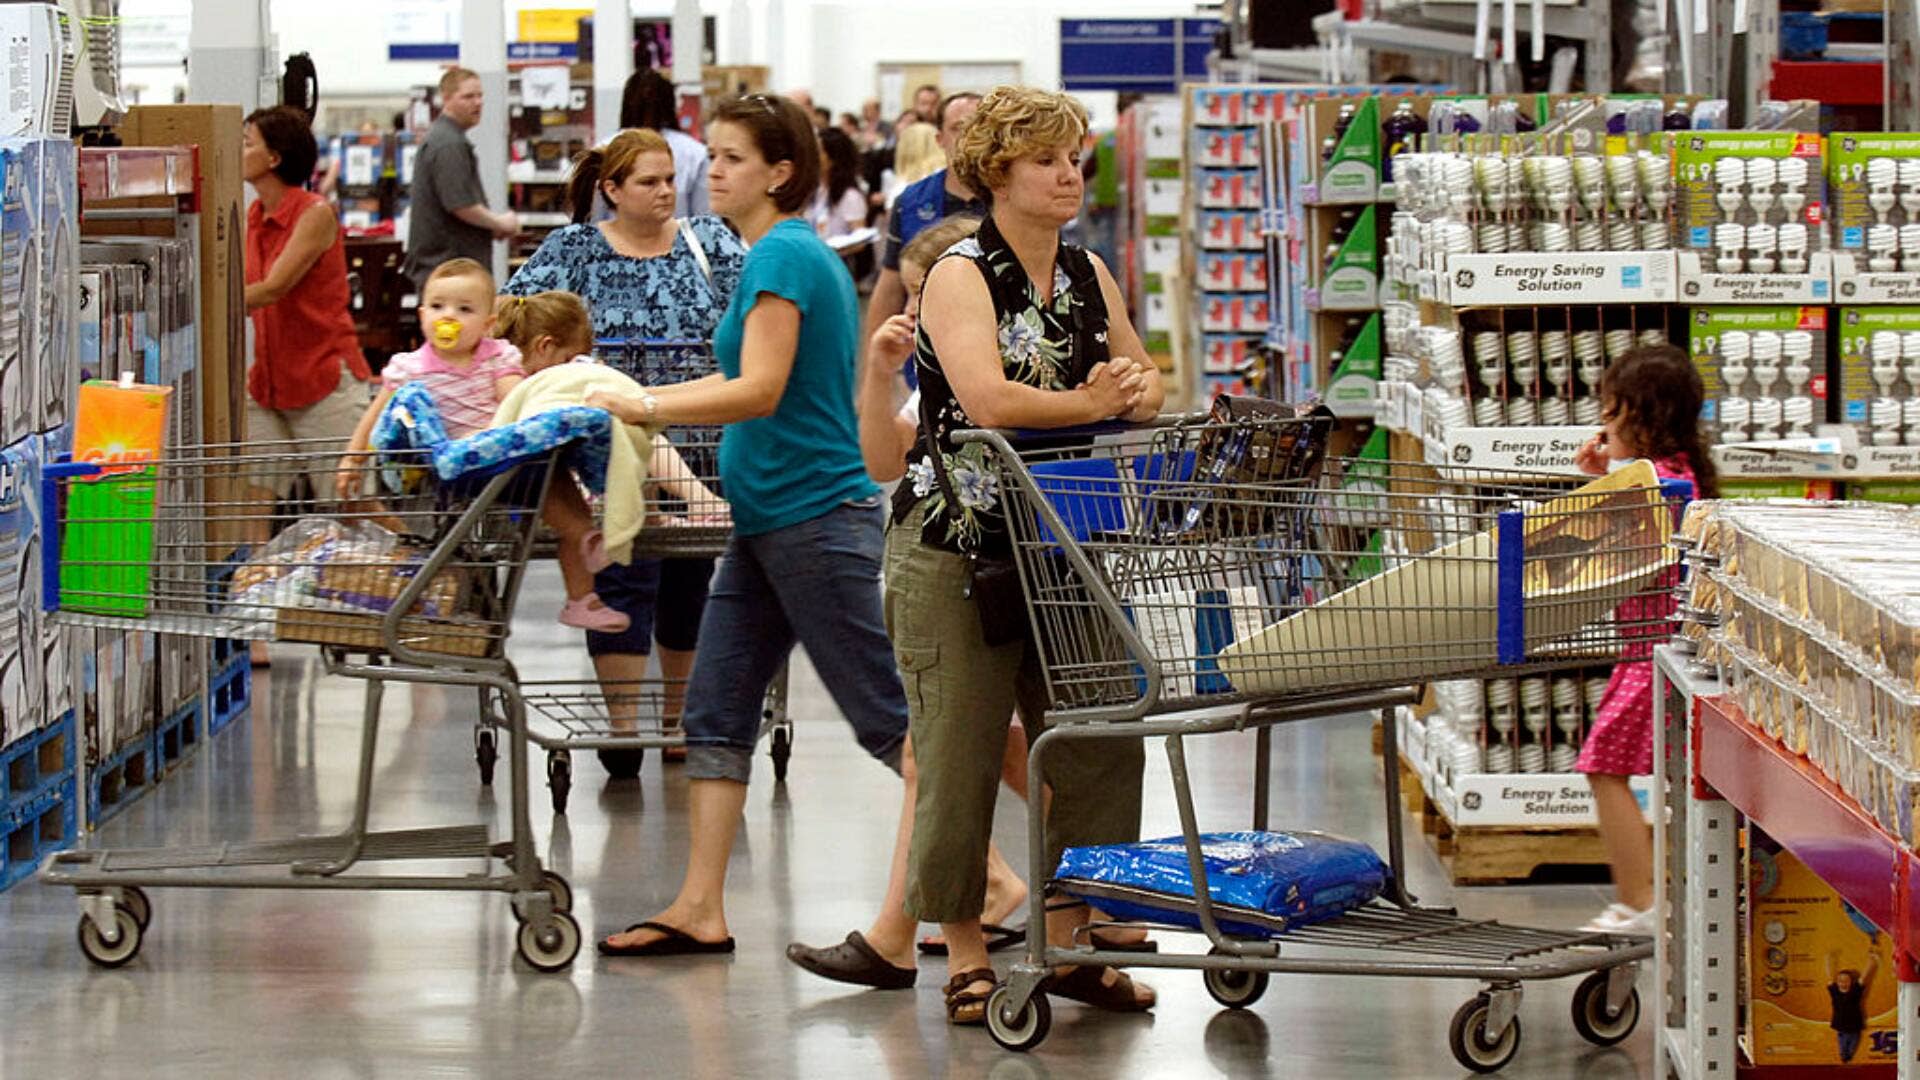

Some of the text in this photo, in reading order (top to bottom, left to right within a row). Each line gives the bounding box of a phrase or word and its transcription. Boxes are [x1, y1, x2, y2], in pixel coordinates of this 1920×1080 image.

[1494, 263, 1605, 279] Energy Saving
[1517, 278, 1583, 292] Solution
[1713, 276, 1802, 290] Energy Saving
[1869, 276, 1911, 290] Energy
[1731, 289, 1784, 300] Solution
[1492, 439, 1588, 454] Energy Savi
[1723, 452, 1765, 464] Energy
[1871, 451, 1912, 463] Energy
[1740, 463, 1792, 474] Solution
[1502, 786, 1594, 801] Energy Savi
[1524, 802, 1590, 815] Solution
